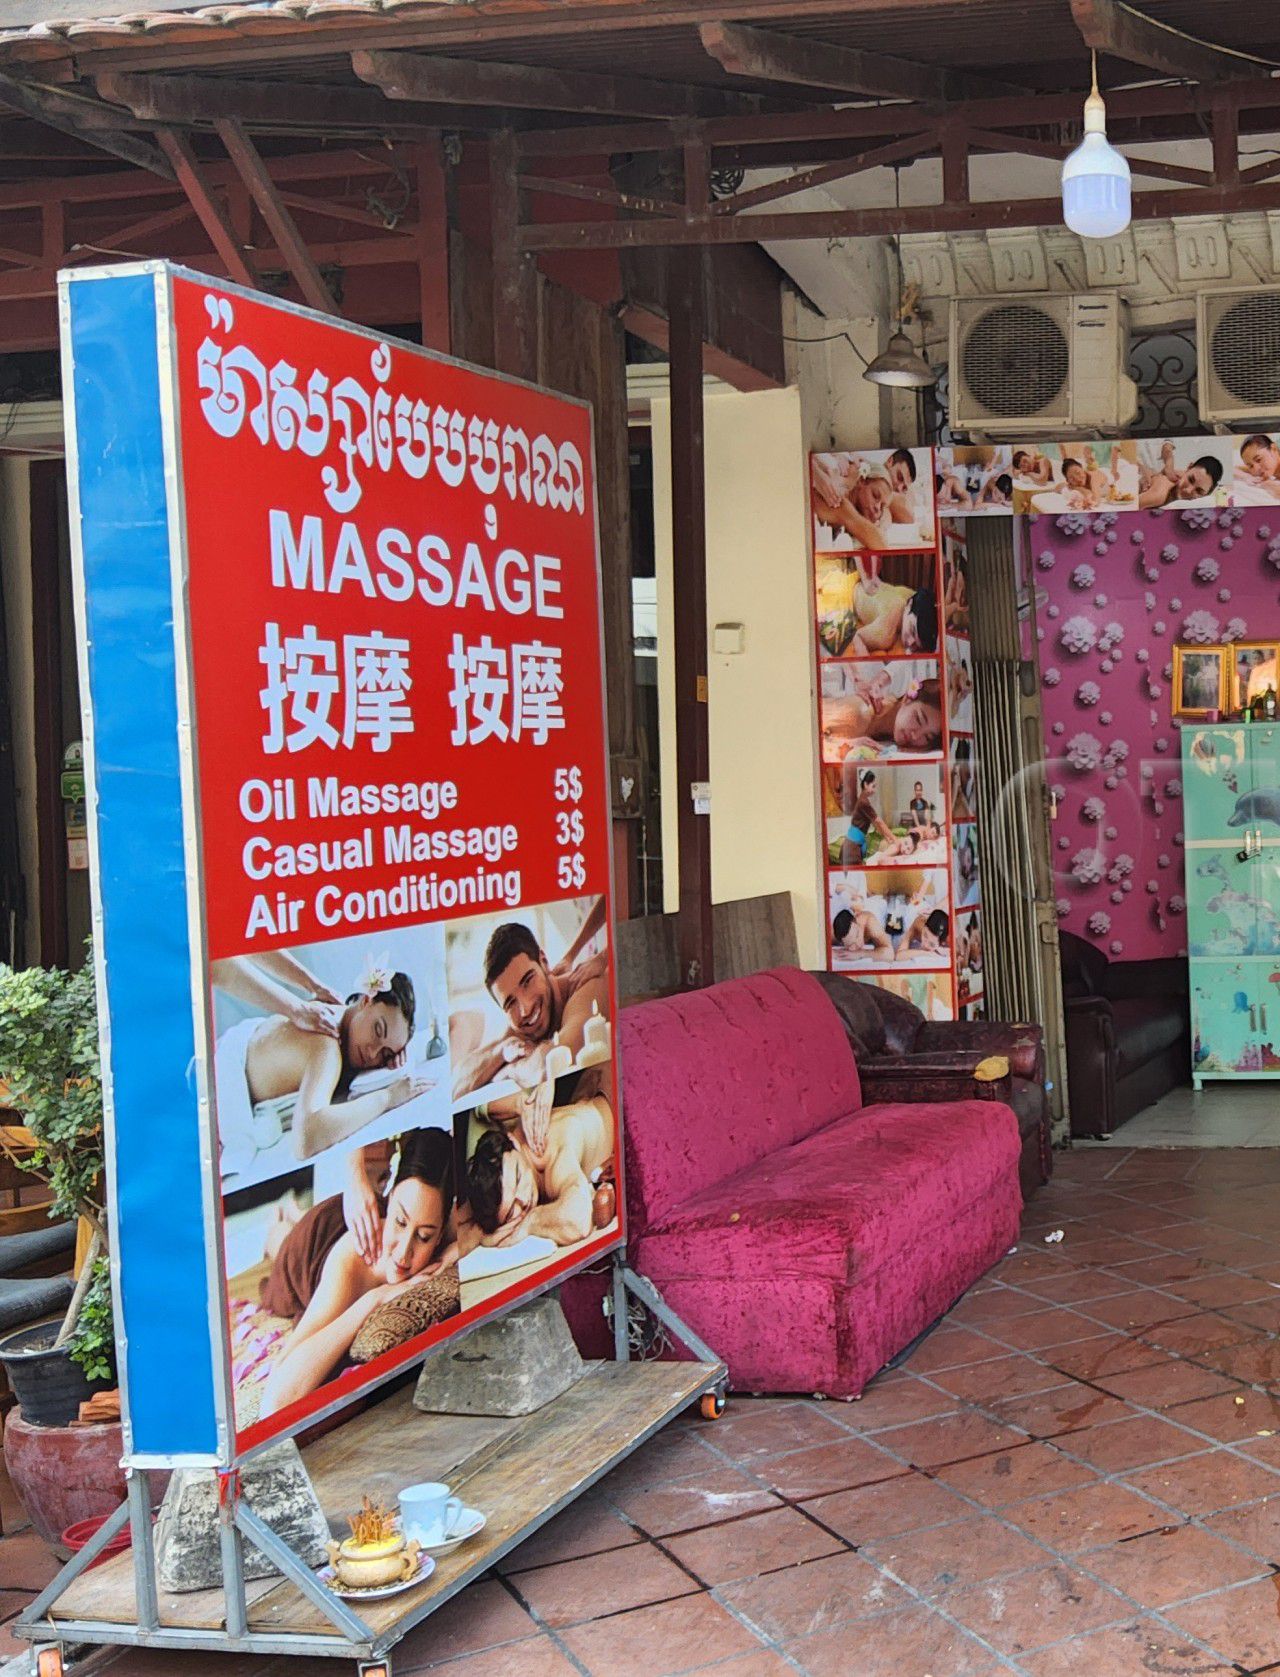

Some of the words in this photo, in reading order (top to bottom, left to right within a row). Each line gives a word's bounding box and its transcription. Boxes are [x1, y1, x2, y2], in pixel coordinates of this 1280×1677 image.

[269, 508, 564, 619] MASSAGE
[258, 622, 414, 753] 按摩
[448, 633, 566, 746] 按摩
[239, 778, 296, 823] Oil
[307, 776, 458, 819] Massage
[554, 766, 583, 803] 5$
[242, 828, 374, 880] Casual
[383, 823, 519, 865] Massage
[555, 809, 585, 847] 3$
[244, 892, 305, 939] Air
[314, 866, 521, 927] Conditioning
[557, 852, 587, 890] 5$
